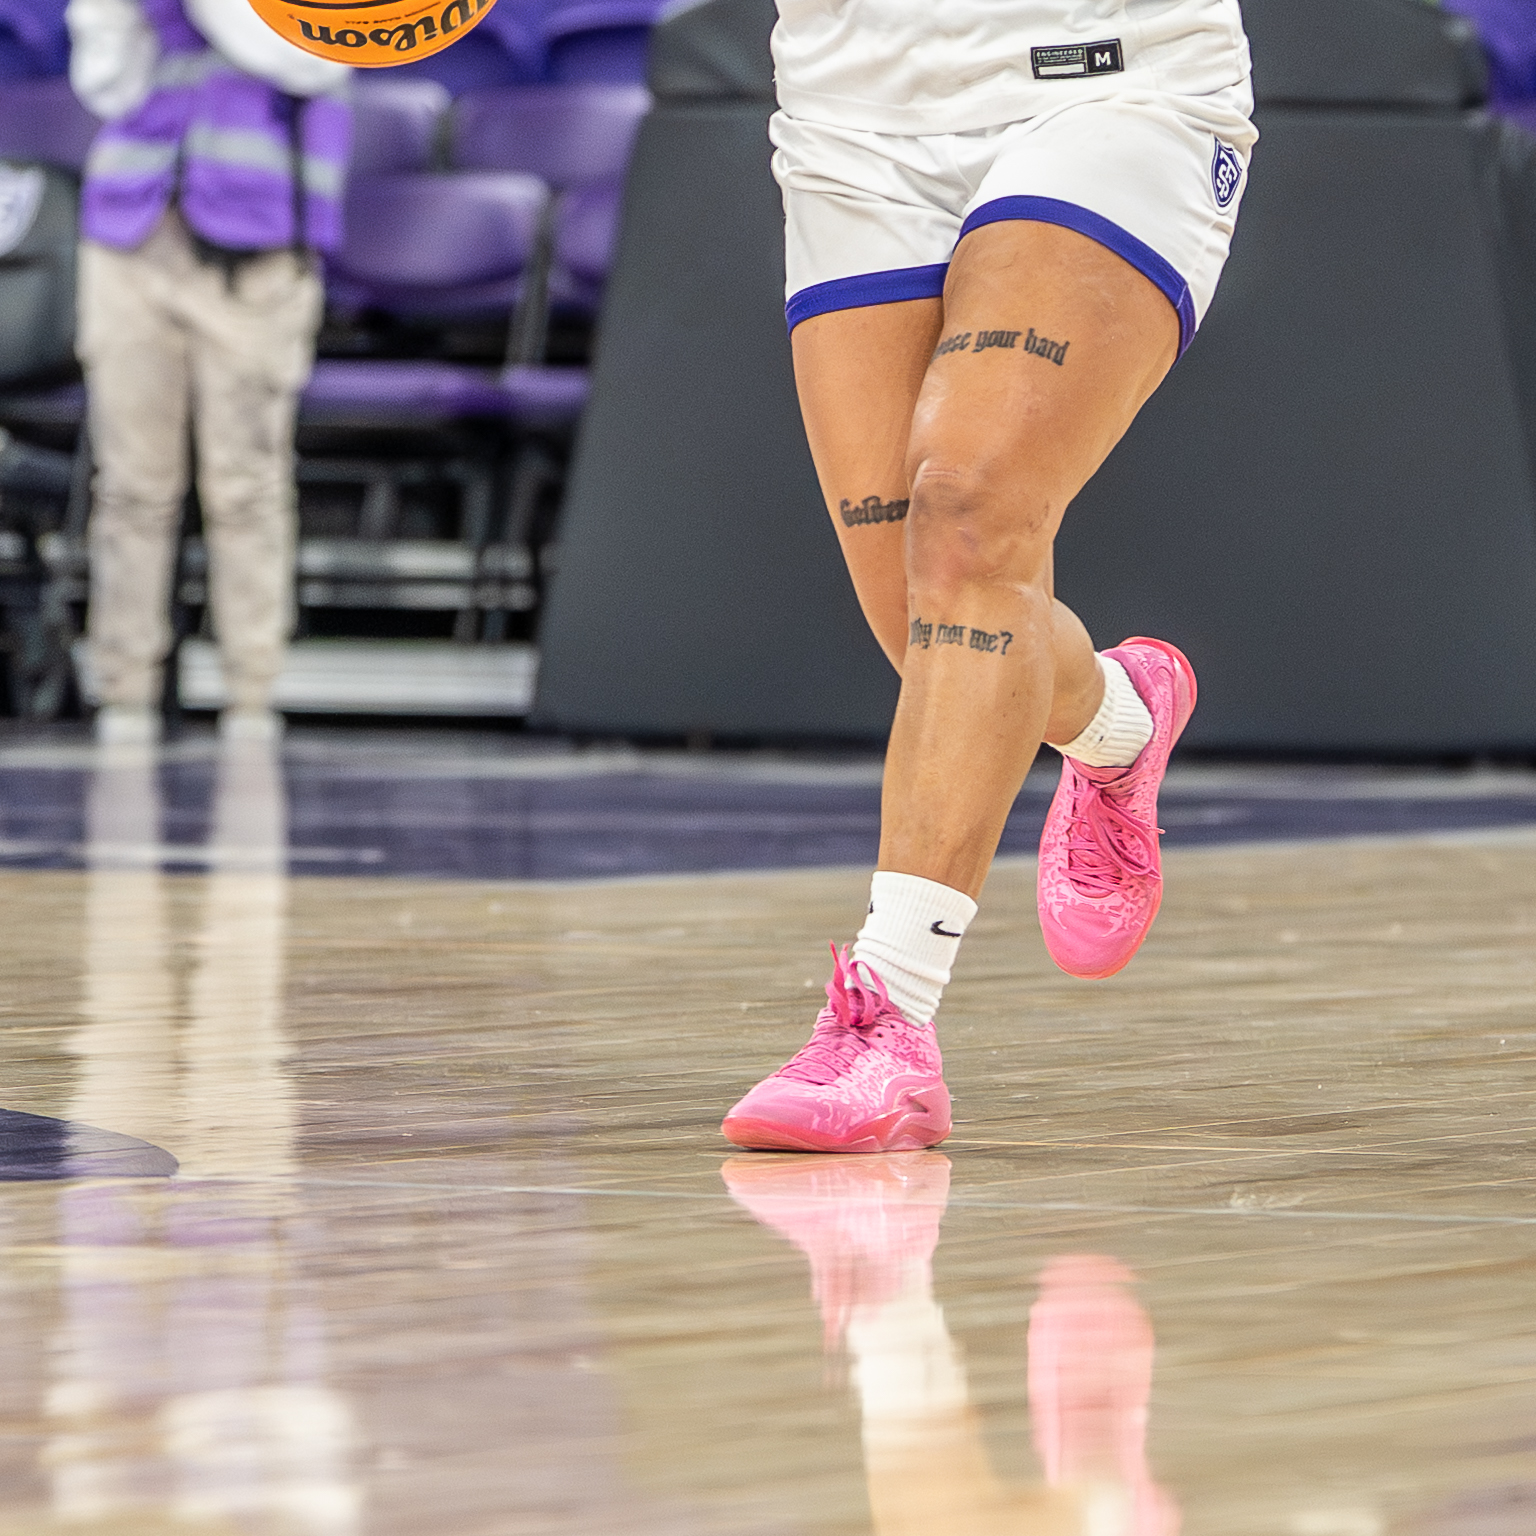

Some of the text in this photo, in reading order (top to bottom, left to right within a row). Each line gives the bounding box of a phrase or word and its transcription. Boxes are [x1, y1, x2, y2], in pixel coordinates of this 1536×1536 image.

[1094, 51, 1112, 67] M
[971, 330, 1023, 353] your
[1023, 327, 1071, 366] hard
[969, 627, 1014, 655] me?
